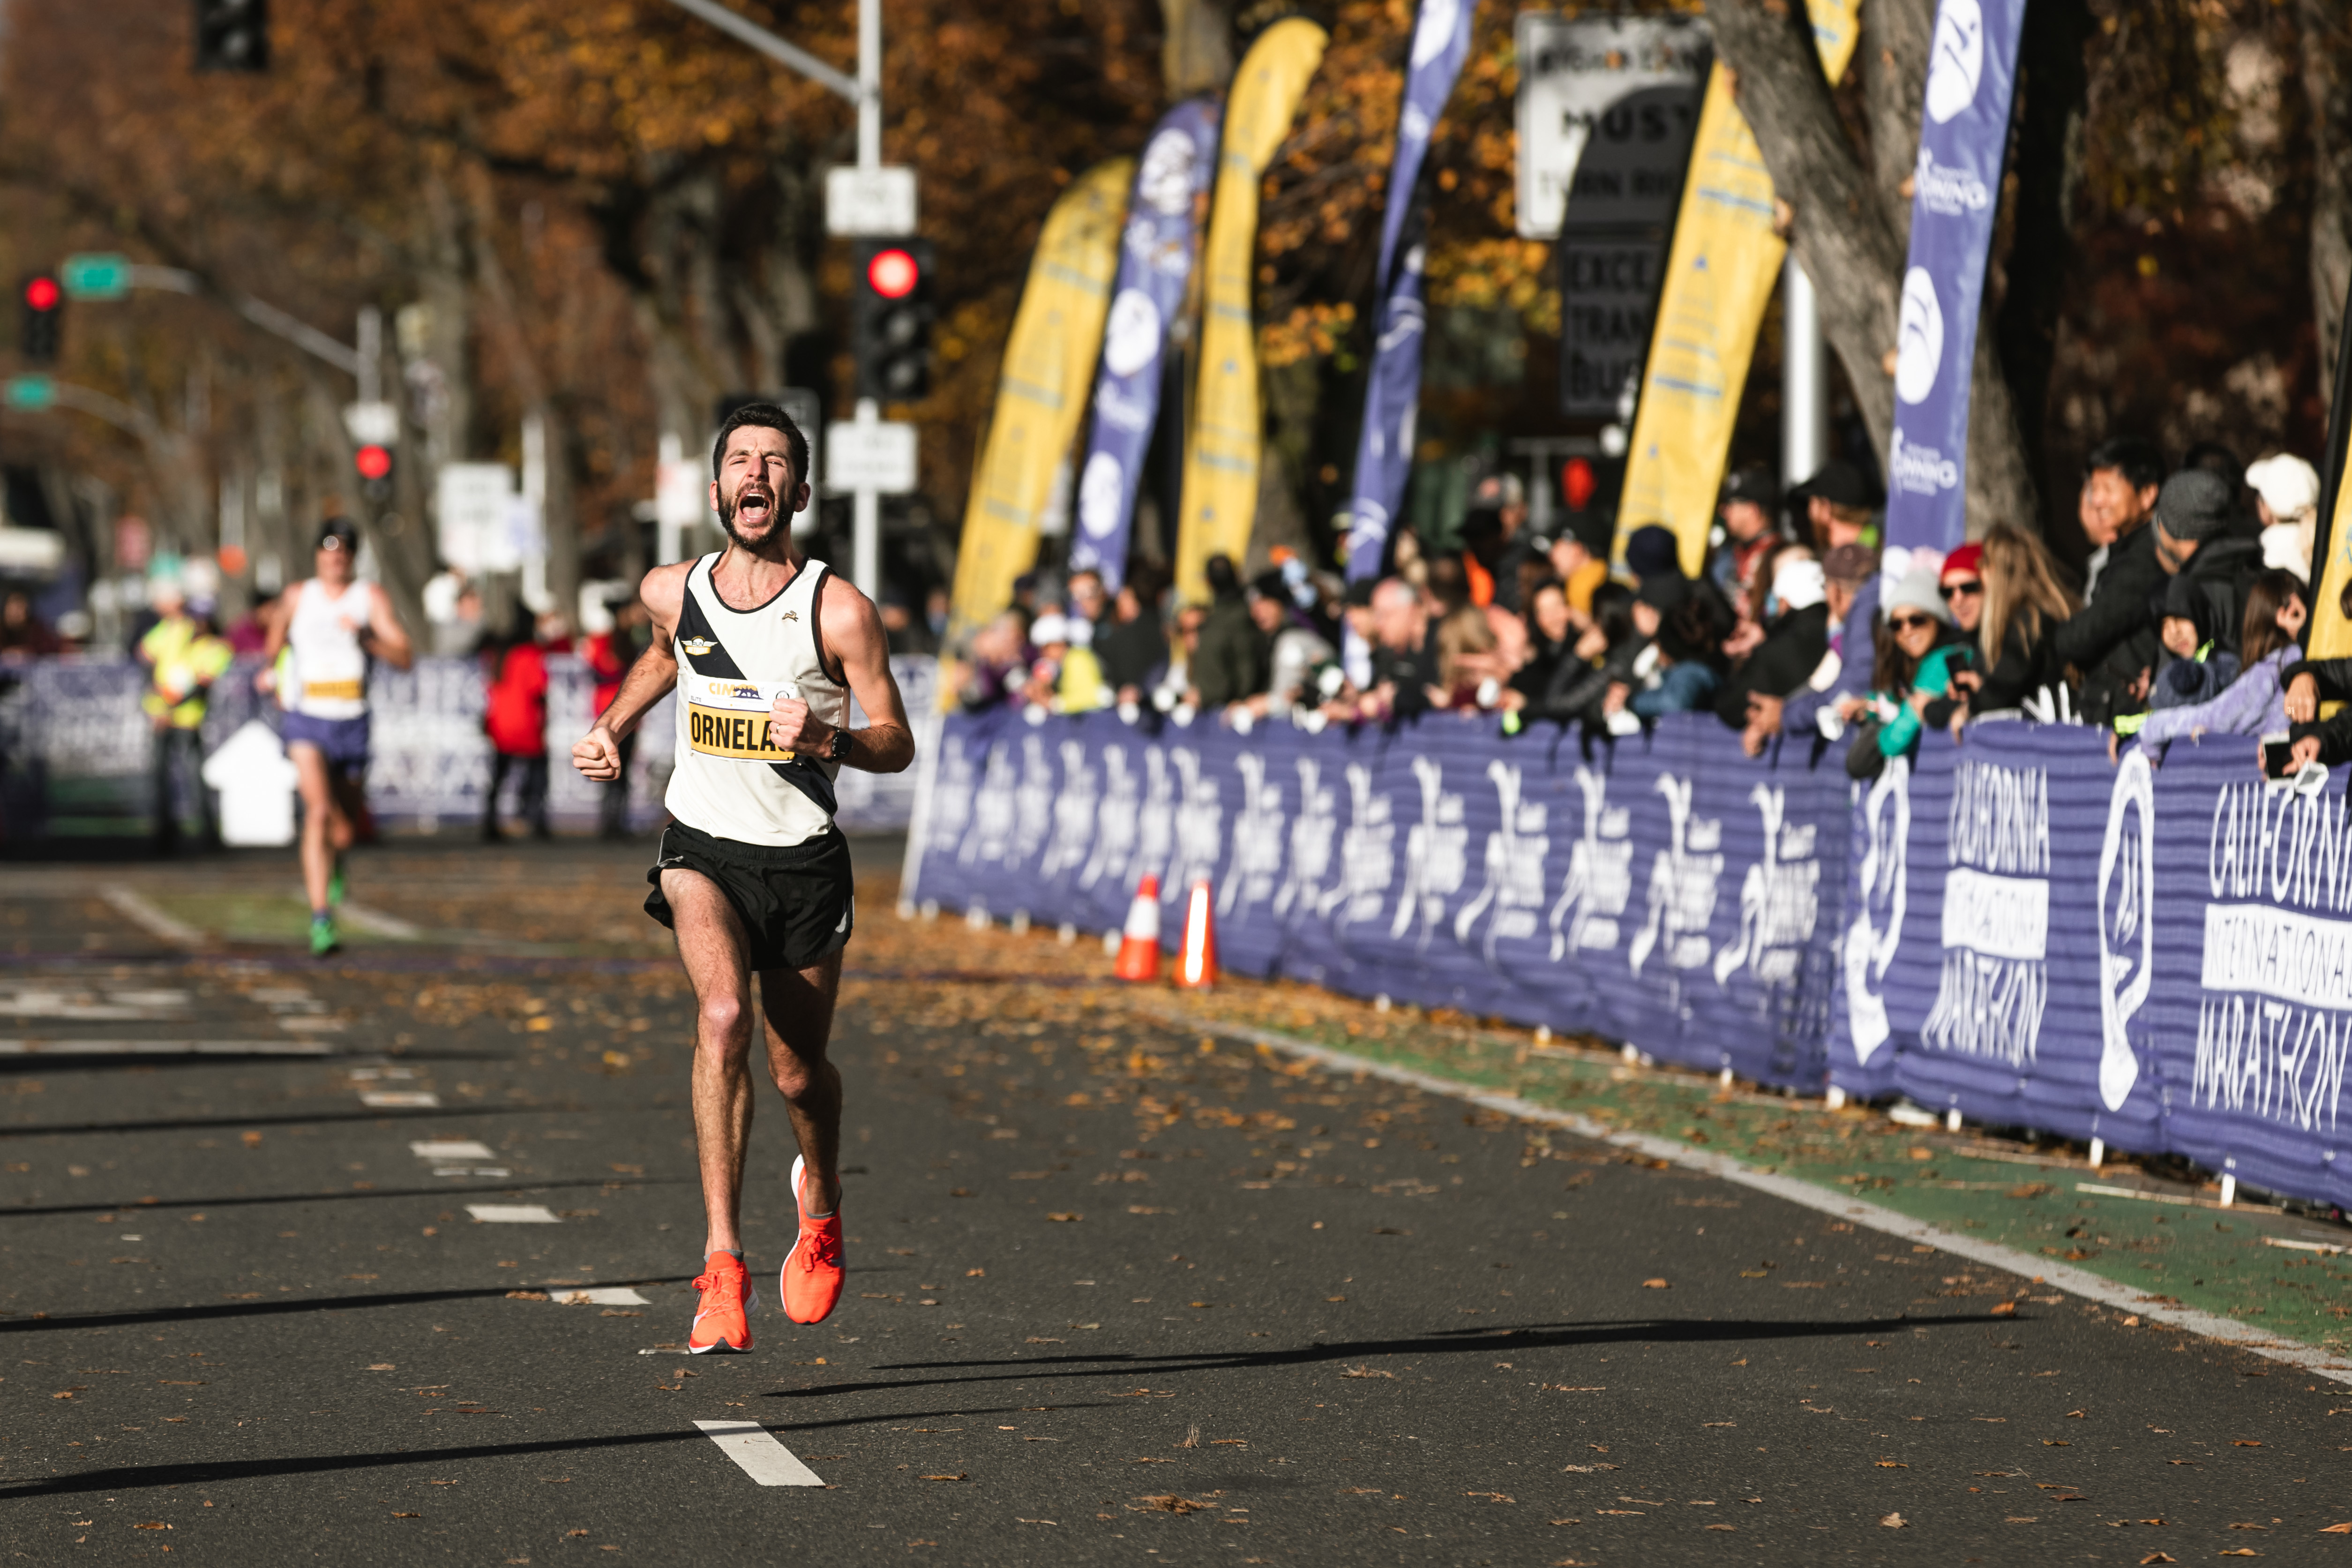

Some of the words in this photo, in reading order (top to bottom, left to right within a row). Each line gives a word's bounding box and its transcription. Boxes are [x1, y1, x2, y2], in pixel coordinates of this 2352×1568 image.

[1570, 251, 1651, 291] EXCE
[1572, 305, 1647, 341] TRAN
[709, 683, 736, 697] CIM
[691, 712, 787, 752] ORNELA
[1948, 759, 2050, 875] CALIFORNIA
[1921, 946, 2047, 1069] MARATHON
[2191, 994, 2352, 1133] MARATHON
